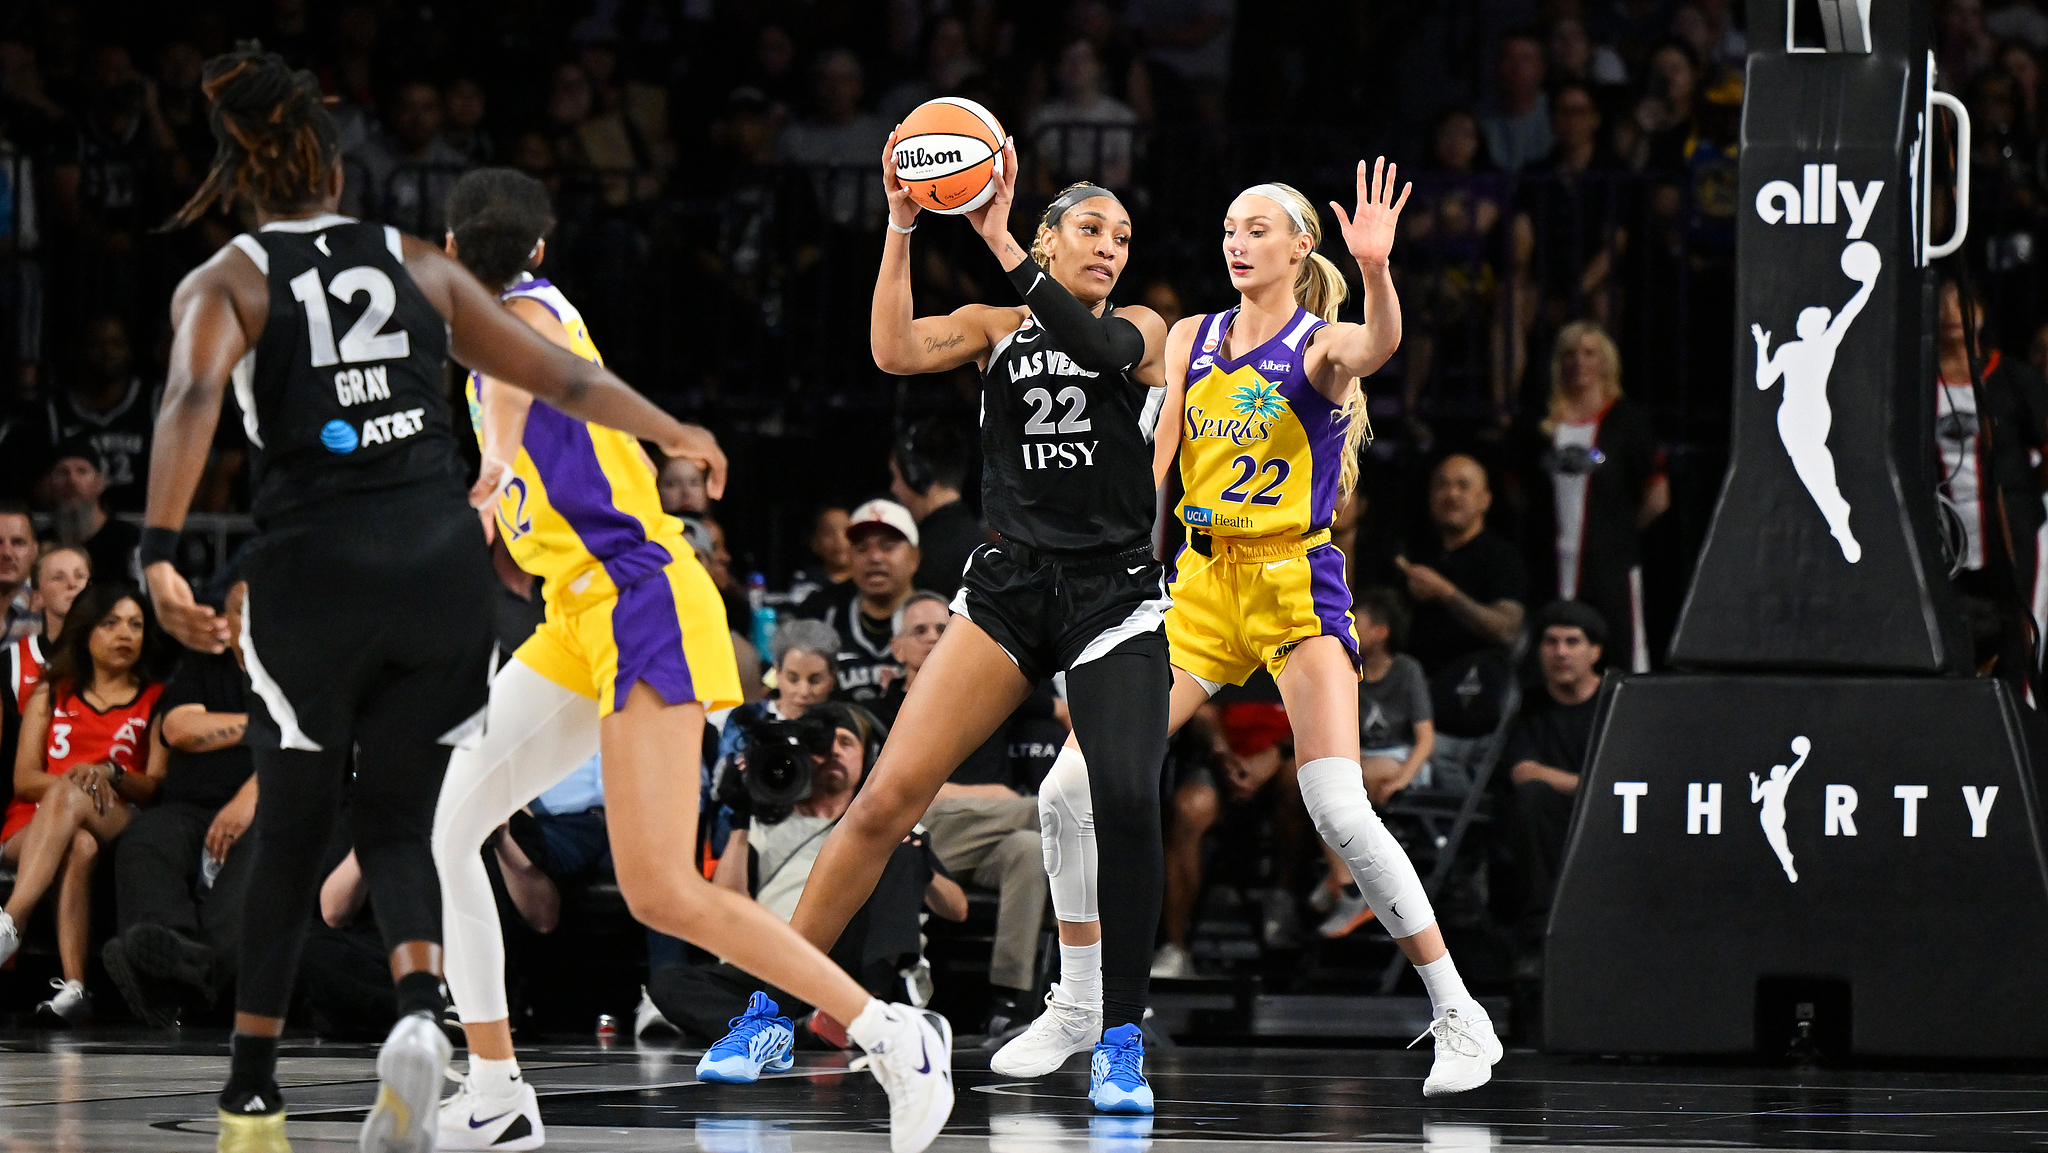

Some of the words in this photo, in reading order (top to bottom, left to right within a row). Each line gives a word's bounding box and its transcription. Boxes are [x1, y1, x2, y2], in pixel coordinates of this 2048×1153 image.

[897, 148, 963, 170] Wilson
[1756, 164, 1885, 239] ally
[289, 265, 410, 368] 12
[1008, 351, 1043, 383] LAS
[1258, 360, 1292, 373] Albert
[334, 365, 391, 407] GRAY
[361, 407, 425, 448] AT&T
[1023, 386, 1092, 435] 22
[1021, 440, 1099, 470] IPSY
[1220, 455, 1291, 507] 22
[1187, 510, 1208, 523] UCLA
[1214, 513, 1253, 528] Health
[49, 723, 72, 759] 3
